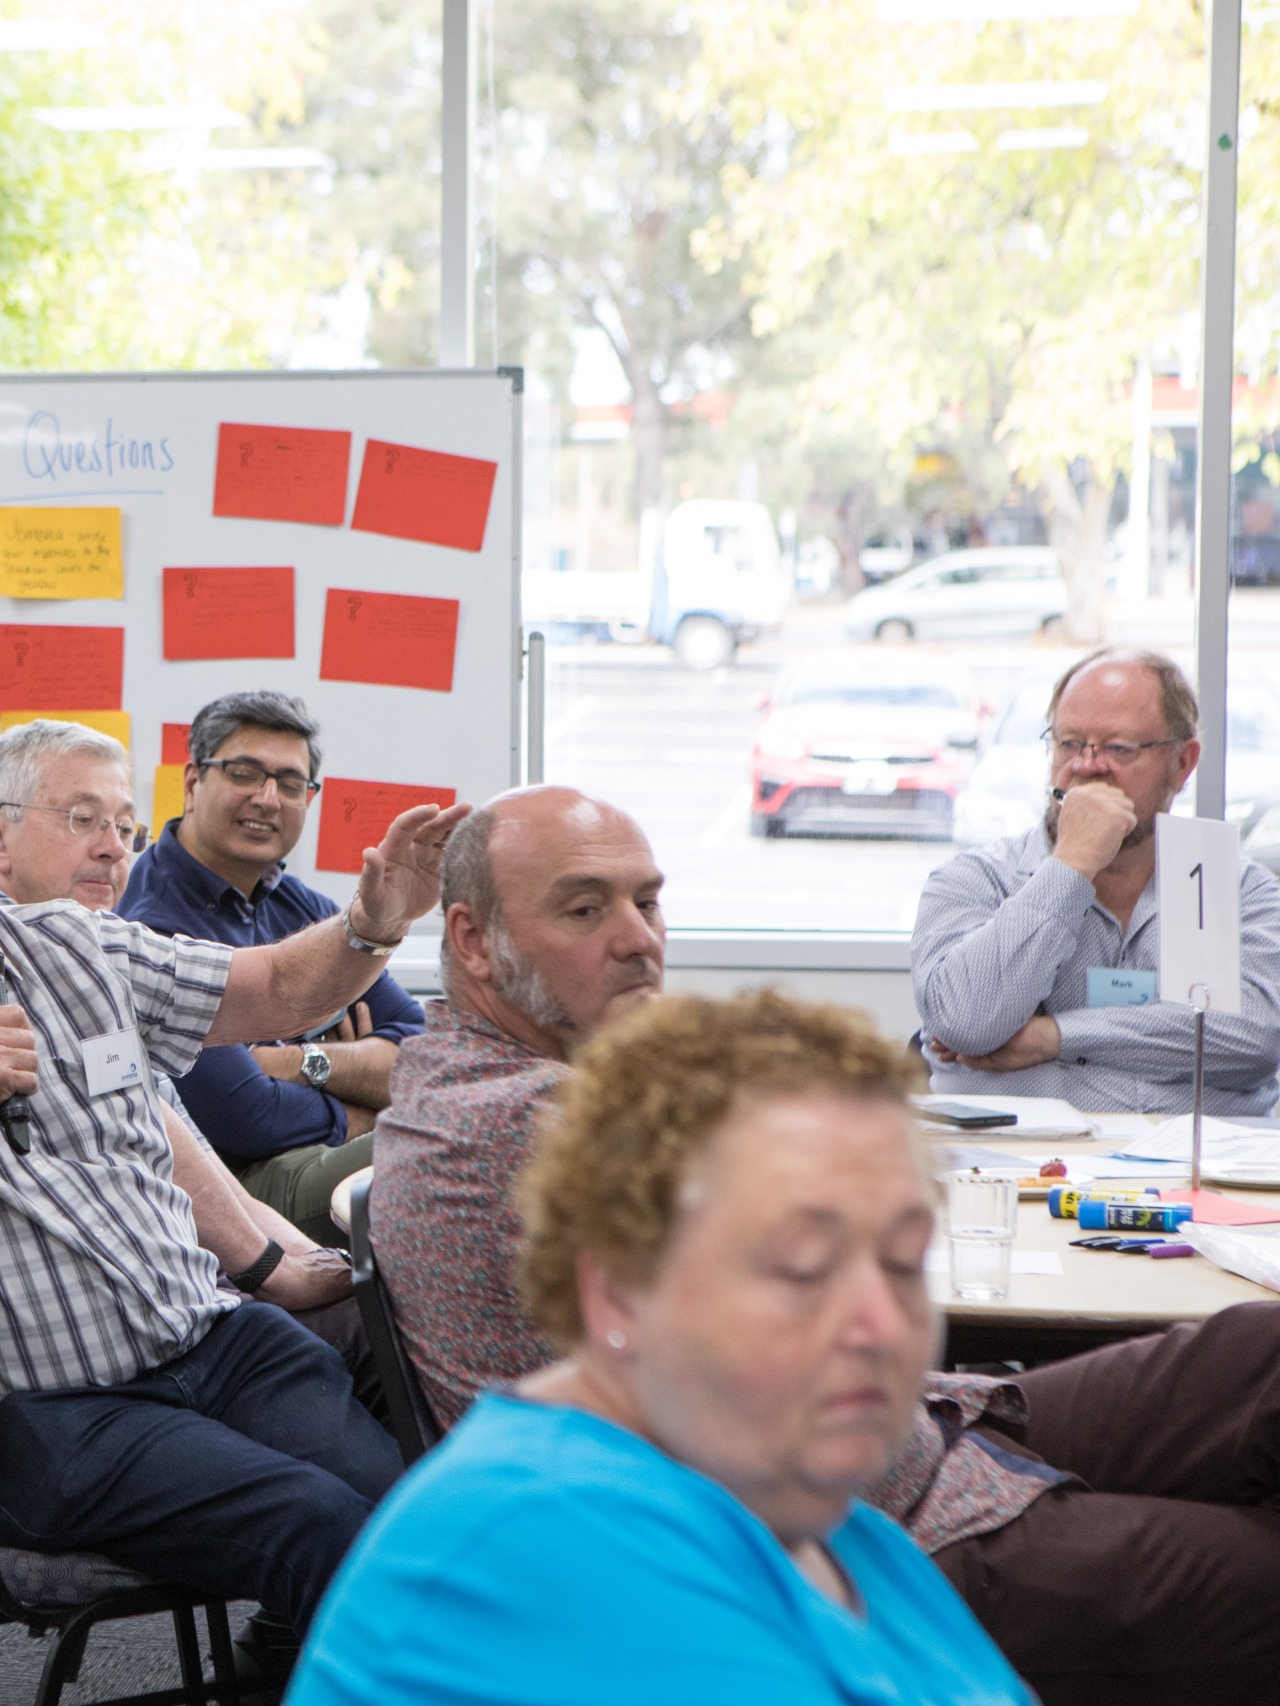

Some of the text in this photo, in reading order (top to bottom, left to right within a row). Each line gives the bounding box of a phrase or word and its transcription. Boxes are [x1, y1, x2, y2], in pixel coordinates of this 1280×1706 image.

[23, 410, 175, 482] Questions
[1189, 862, 1204, 931] 1
[1111, 978, 1134, 989] Mark
[106, 1053, 120, 1064] Jim
